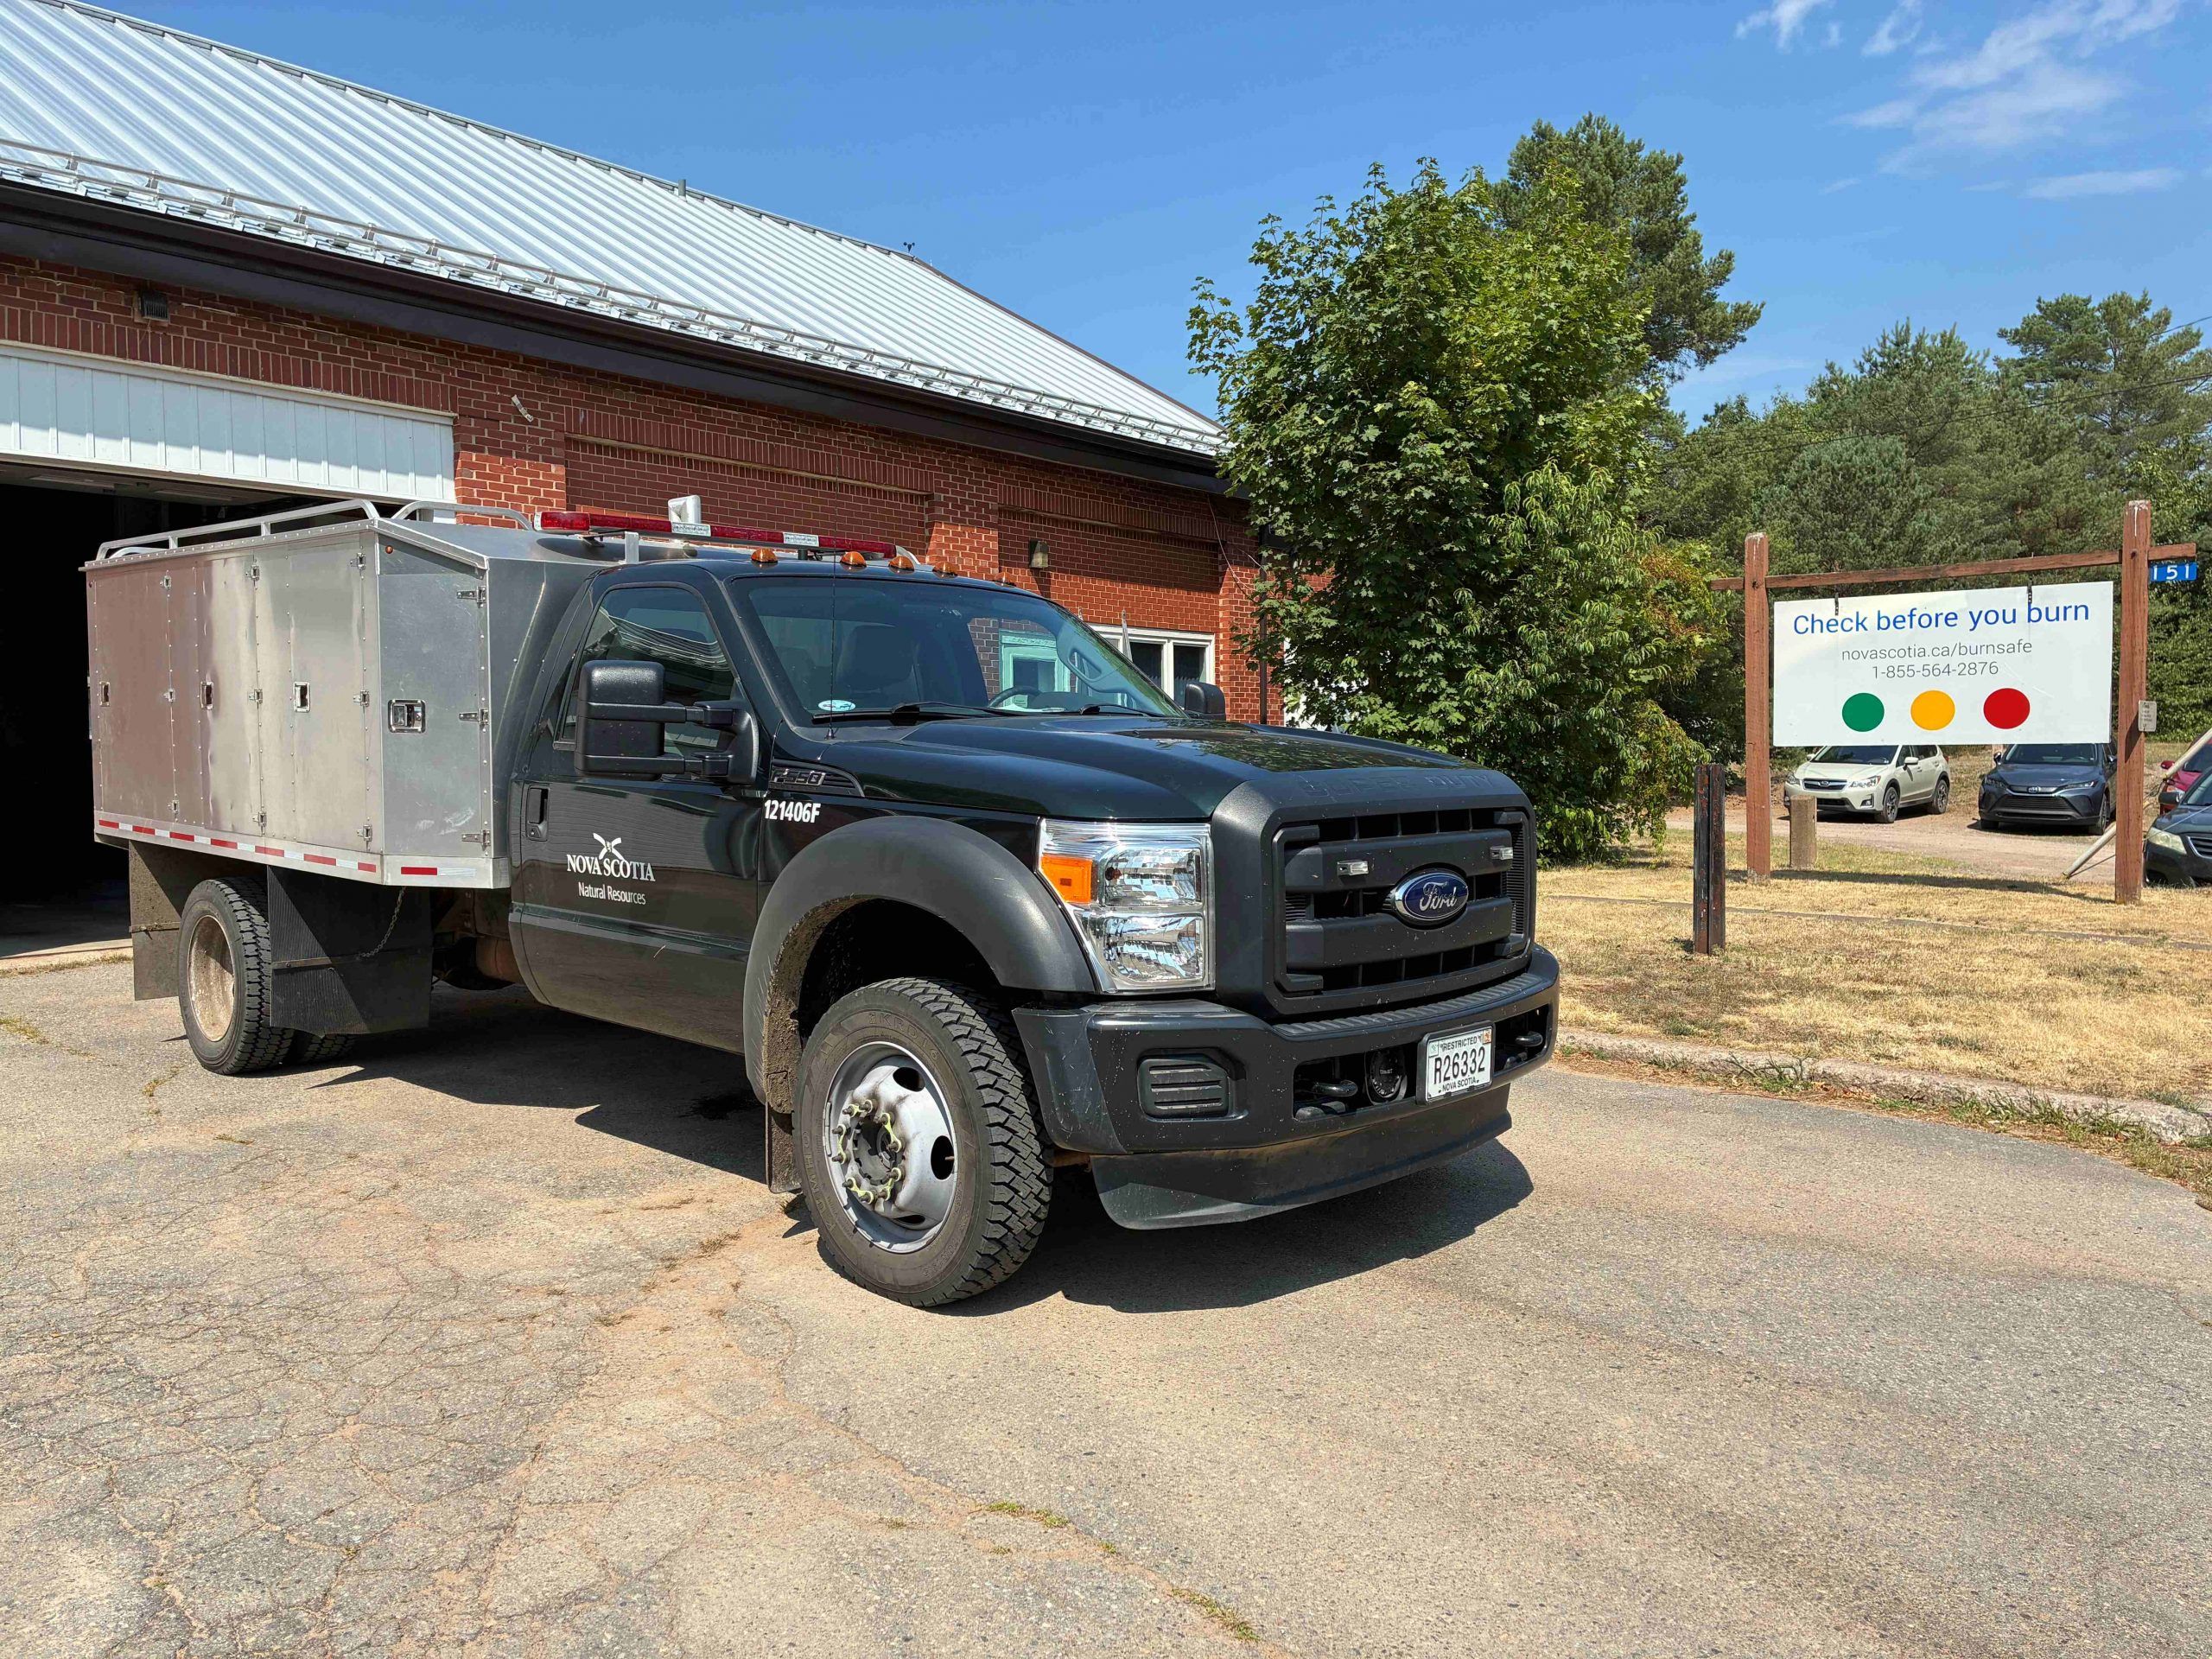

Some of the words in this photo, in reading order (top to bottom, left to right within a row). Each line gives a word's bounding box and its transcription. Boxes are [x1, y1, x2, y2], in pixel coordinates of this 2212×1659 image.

[2152, 563, 2190, 581] 151
[1793, 611, 1868, 635] Check
[1877, 607, 1958, 632] before
[1968, 607, 2018, 632] you
[2027, 602, 2089, 624] burn
[1841, 639, 2033, 661] novascotia.ca/burnsafe
[1872, 661, 1999, 680] 1-855-564-2876
[764, 799, 822, 823] 121406F
[567, 854, 602, 876] NOVA
[603, 858, 656, 882] SCOTIA
[578, 881, 607, 900] Natural
[607, 885, 646, 906] Resources
[1420, 881, 1458, 911] Ford
[1442, 1035, 1478, 1052] RESTRICTED
[1433, 1046, 1485, 1085] R26332
[1442, 1081, 1457, 1092] NOVA
[1457, 1076, 1476, 1088] SCOTIA
